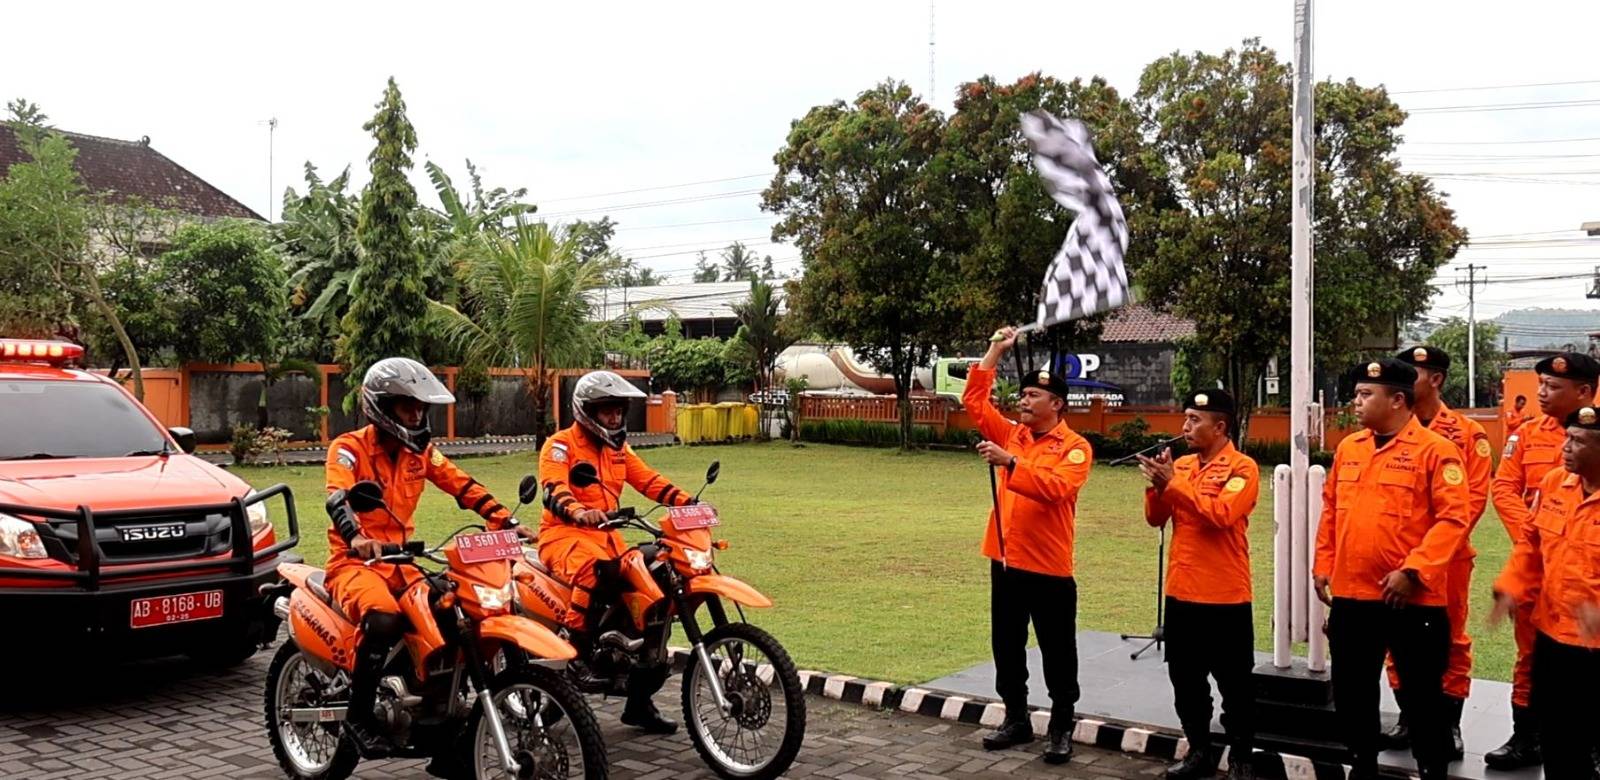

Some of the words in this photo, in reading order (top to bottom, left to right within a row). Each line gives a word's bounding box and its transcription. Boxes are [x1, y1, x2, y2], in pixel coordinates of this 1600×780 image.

[123, 526, 184, 541] ISUZU
[458, 537, 471, 549] AB
[474, 534, 499, 547] 5601
[503, 532, 518, 544] UB
[134, 601, 151, 618] AB
[162, 596, 194, 614] 8168
[204, 592, 221, 608] UB
[294, 600, 337, 647] BASARNAS
